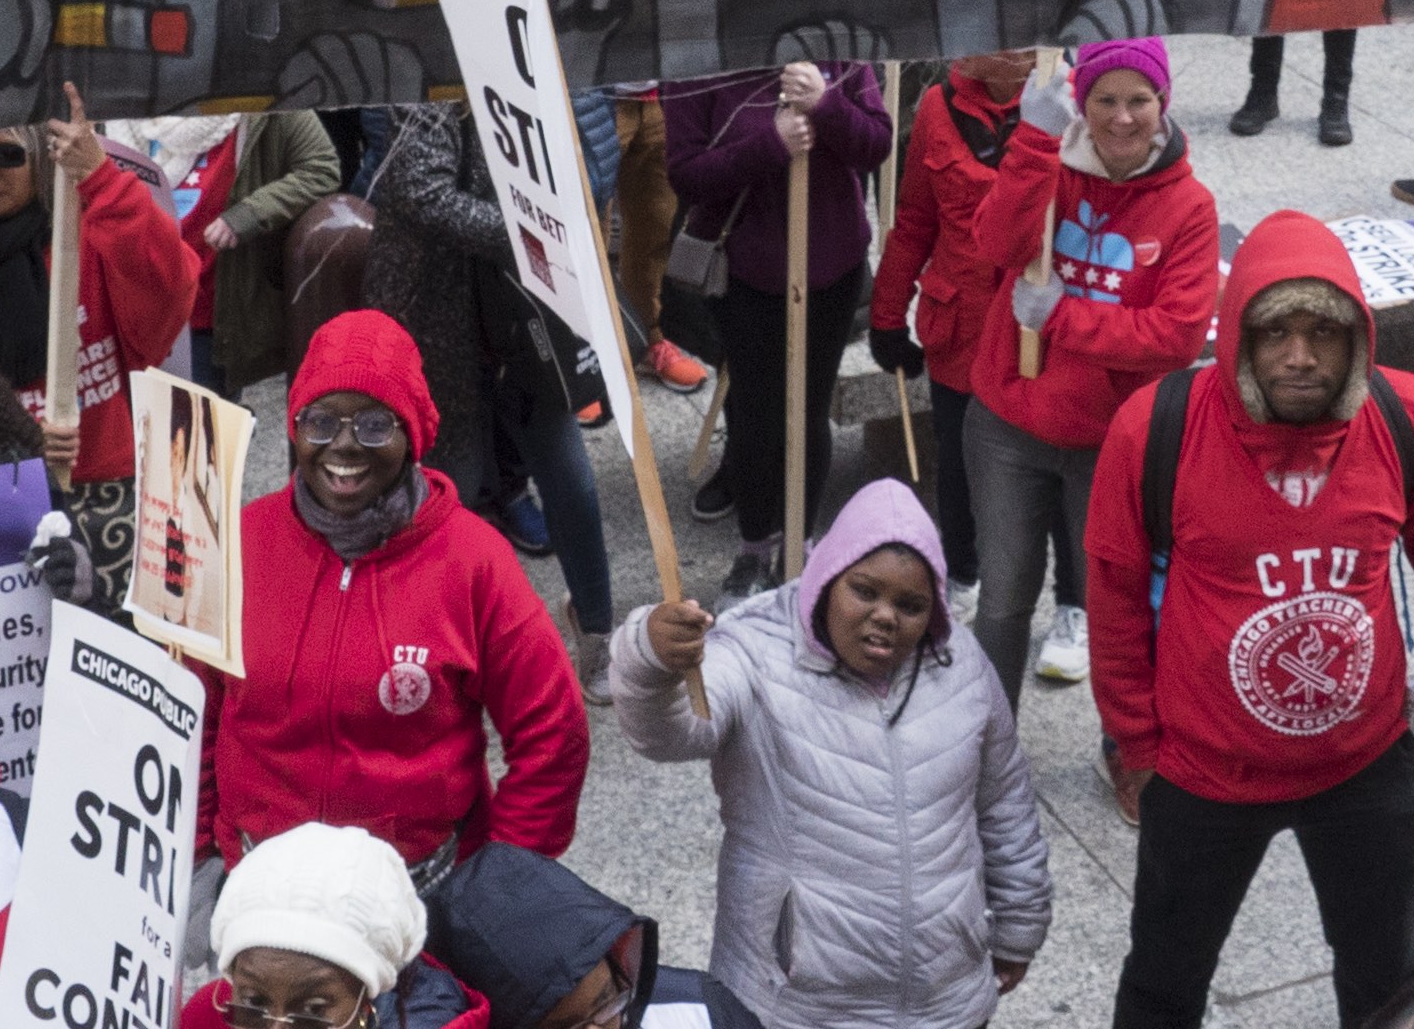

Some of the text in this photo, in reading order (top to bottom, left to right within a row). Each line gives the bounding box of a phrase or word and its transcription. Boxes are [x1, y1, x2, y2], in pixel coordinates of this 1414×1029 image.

[508, 182, 536, 220] FOR
[1256, 547, 1360, 598] CTU
[393, 644, 429, 666] CTU
[1237, 618, 1272, 693] CHICAGO
[77, 647, 197, 734] CHICAGO PUBLIC
[141, 914, 173, 959] for a
[110, 940, 174, 1028] FAI
